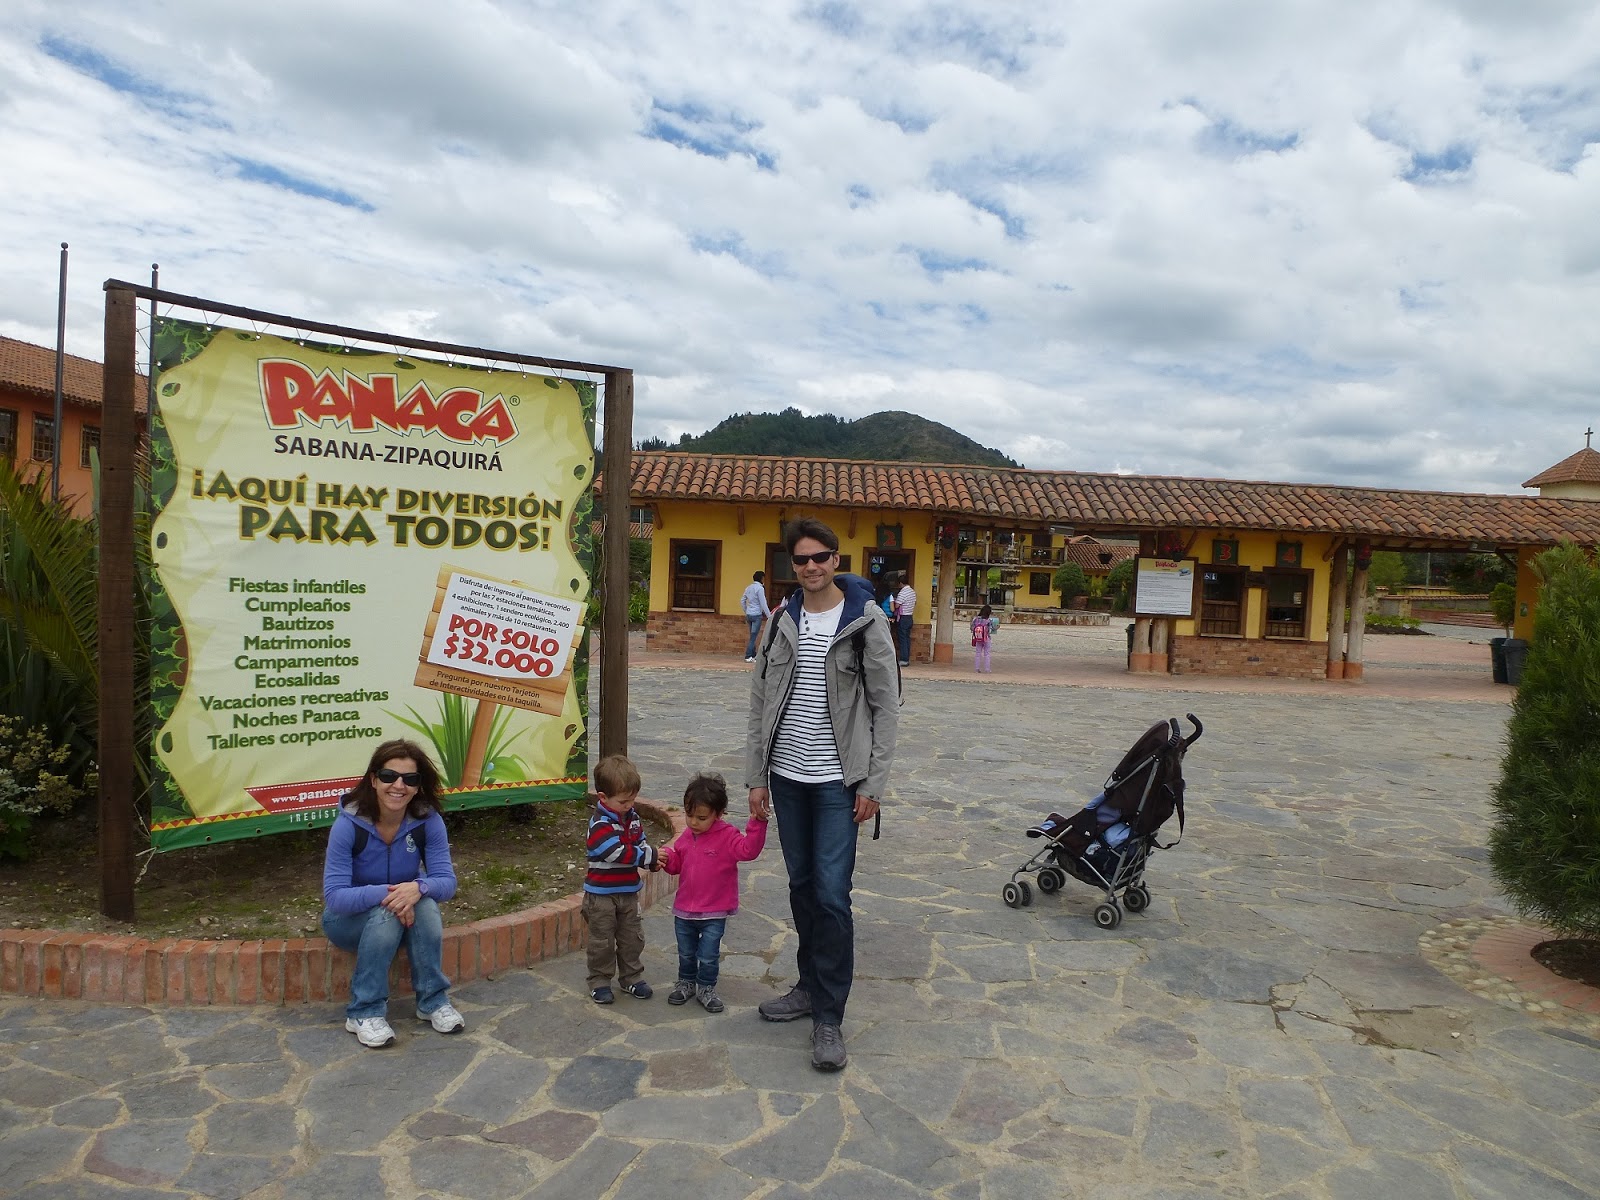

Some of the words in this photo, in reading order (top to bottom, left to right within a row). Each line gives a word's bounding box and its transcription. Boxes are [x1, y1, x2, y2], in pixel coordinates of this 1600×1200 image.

[257, 358, 520, 448] PANACA
[274, 434, 502, 472] SABANA-ZIPAQUIRÁ
[190, 467, 308, 507] ¡AQUÍ
[316, 482, 390, 511] HAY
[396, 487, 563, 522] DIVERSIÓN
[238, 504, 379, 546] PARA
[386, 513, 552, 552] TODOS!
[883, 530, 896, 546] 2
[1220, 544, 1232, 560] 3
[1282, 546, 1296, 562] 4
[228, 577, 289, 592] Fiestas
[293, 578, 366, 594] infantiles
[459, 576, 483, 589] Disfruta
[484, 583, 493, 591] de:
[494, 586, 516, 597] ingreso
[522, 595, 544, 606] parque,
[544, 602, 570, 612] recorrido
[245, 597, 352, 616] Cumpleaños
[456, 594, 495, 610] exhibiciones,
[500, 606, 523, 616] sendero
[524, 613, 552, 625] ecológico,
[496, 596, 526, 608] estaciones
[526, 604, 556, 617] temáticas,
[262, 616, 334, 631] Bautizos
[460, 605, 486, 616] animales
[522, 621, 557, 634] restaurantes
[244, 634, 352, 650] Matrimonios
[448, 614, 498, 642] POR
[500, 628, 560, 656] SOLO
[234, 654, 359, 672] Campamentos
[444, 633, 554, 677] $32.000
[255, 672, 340, 688] Ecosalidas
[436, 670, 469, 684] Pregunta
[470, 678, 484, 688] por
[484, 682, 510, 692] nuestro
[511, 686, 540, 699] Tarjetón
[199, 694, 296, 711] Vacaciones
[300, 688, 389, 705] recreativas
[440, 682, 496, 700] Interactividades
[507, 694, 514, 702] la
[514, 697, 543, 709] taquilla.
[233, 712, 298, 728] Noches
[302, 710, 360, 724] Panaca
[207, 733, 276, 750] Talleres
[280, 724, 382, 746] corporativos
[272, 786, 356, 804] www.panacas
